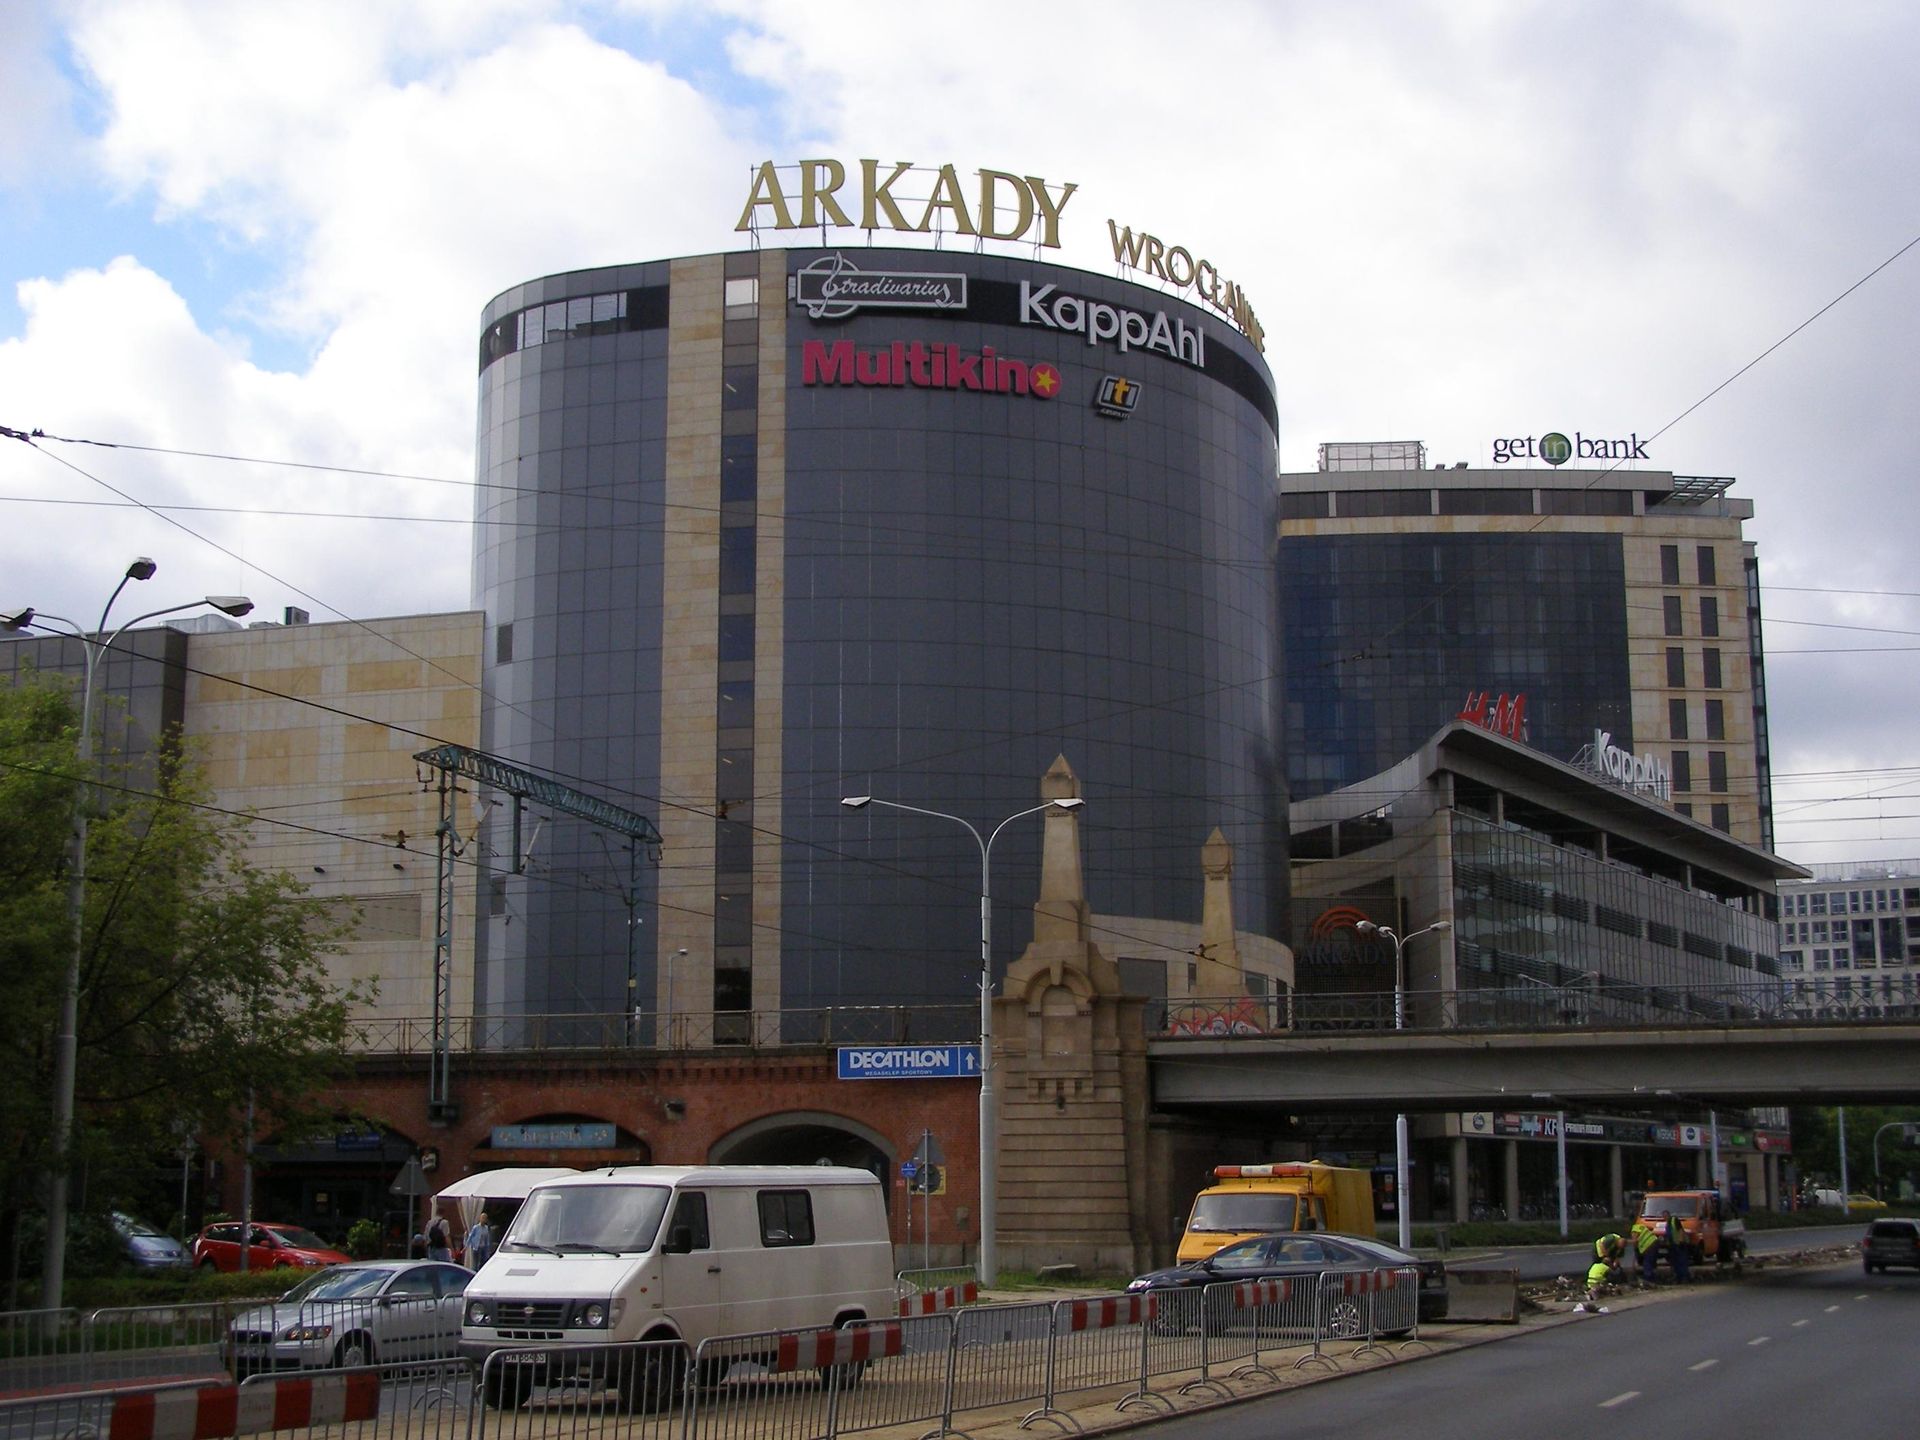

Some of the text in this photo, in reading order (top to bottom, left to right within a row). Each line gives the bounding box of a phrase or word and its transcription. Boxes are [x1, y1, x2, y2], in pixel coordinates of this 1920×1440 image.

[735, 158, 1266, 353] ARKADY WROCŁAW
[1019, 280, 1206, 368] KappAhl
[802, 340, 1062, 398] Multikino
[1575, 432, 1650, 460] bank
[1594, 728, 1671, 802] KappAhl
[849, 1050, 949, 1069] DECATHLON
[1544, 1117, 1561, 1136] KF
